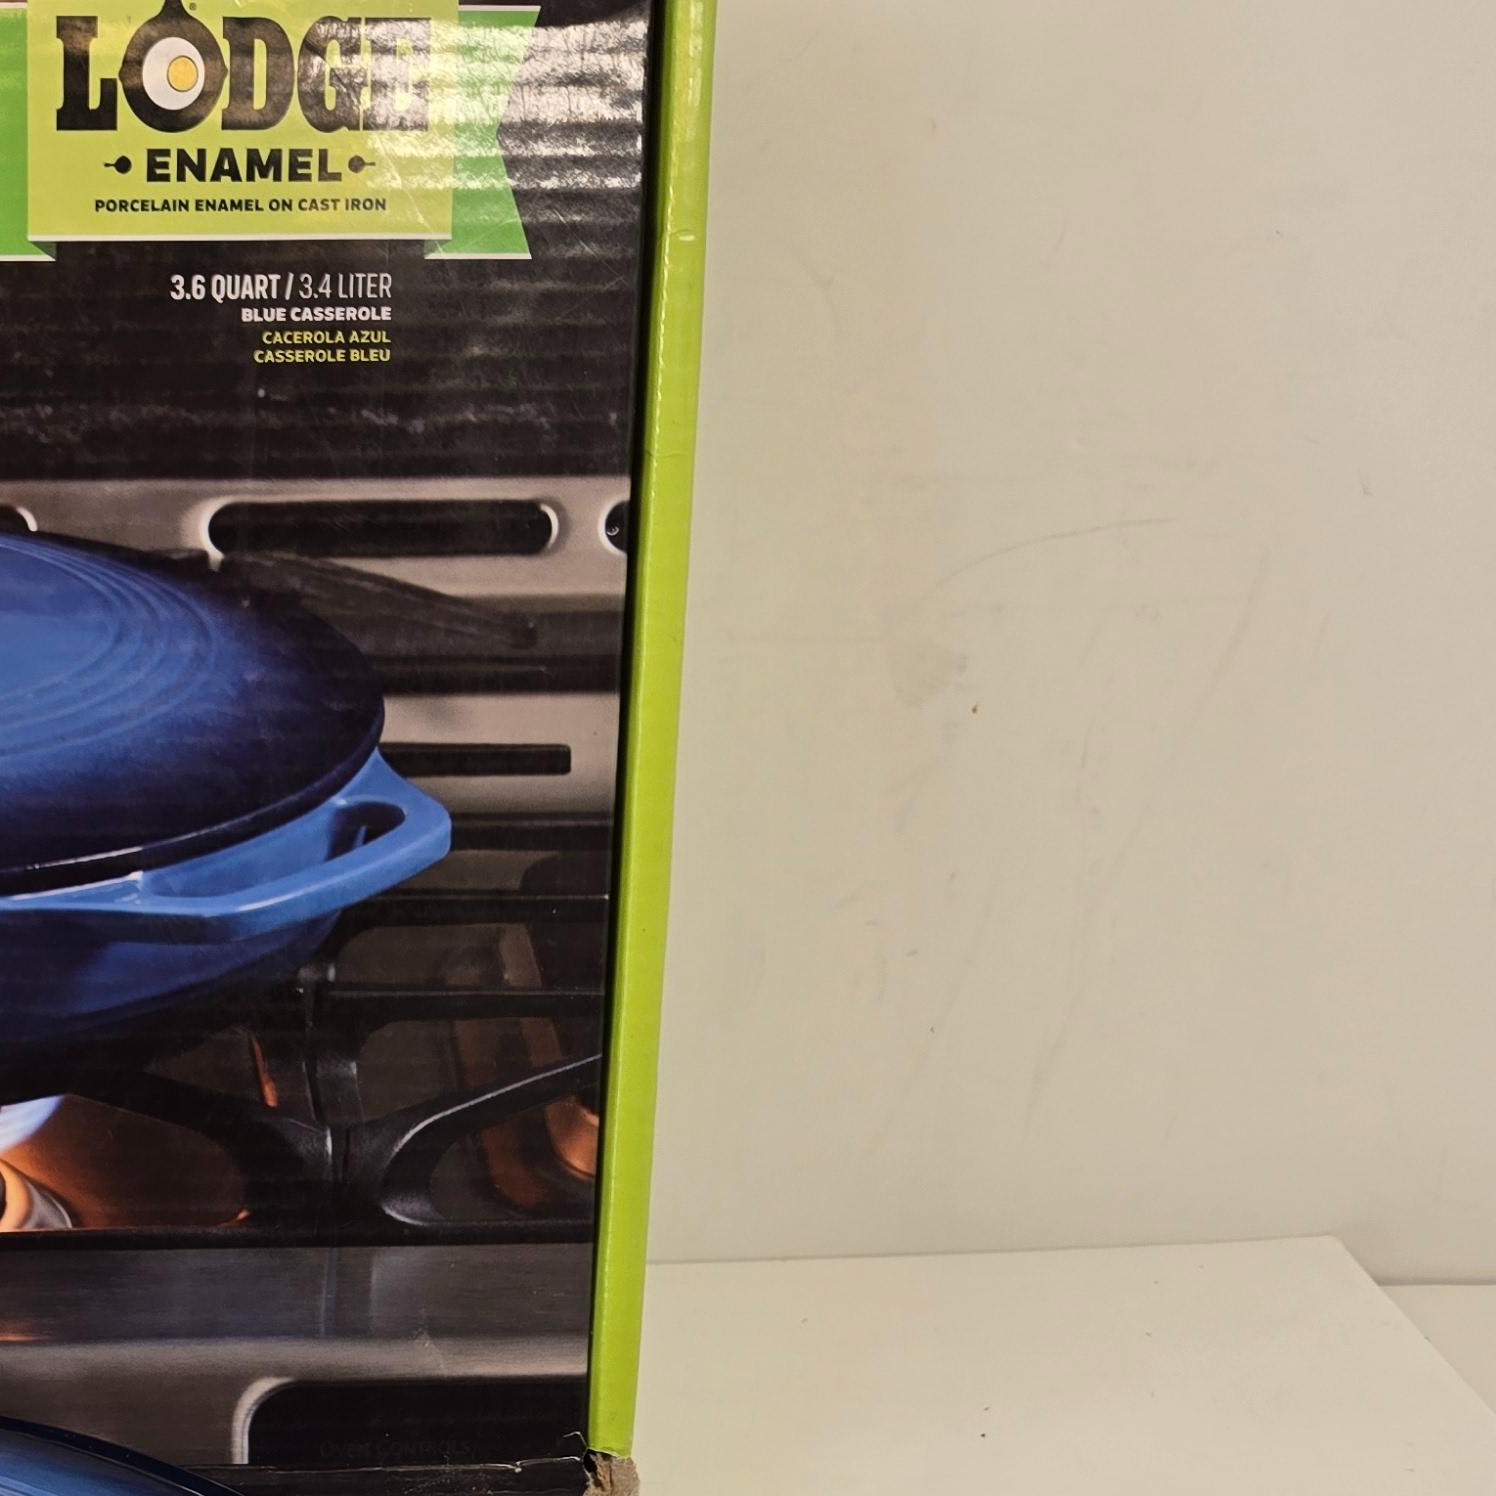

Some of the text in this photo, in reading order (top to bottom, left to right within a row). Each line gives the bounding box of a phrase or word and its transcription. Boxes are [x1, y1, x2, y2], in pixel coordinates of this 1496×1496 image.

[55, 0, 432, 133] LODGE
[146, 148, 343, 183] ENAMEL
[94, 198, 387, 213] PORCELAIN ENAMEL ON CAST IRON
[170, 274, 205, 300] 3.6
[210, 274, 281, 303] QUART
[298, 273, 332, 299] 3.4
[338, 273, 392, 298] LITER
[241, 307, 392, 322] BLUE CASSEROLE
[262, 331, 391, 344] CACEROLA AZUL
[254, 349, 391, 363] CASSEROLE BLEU
